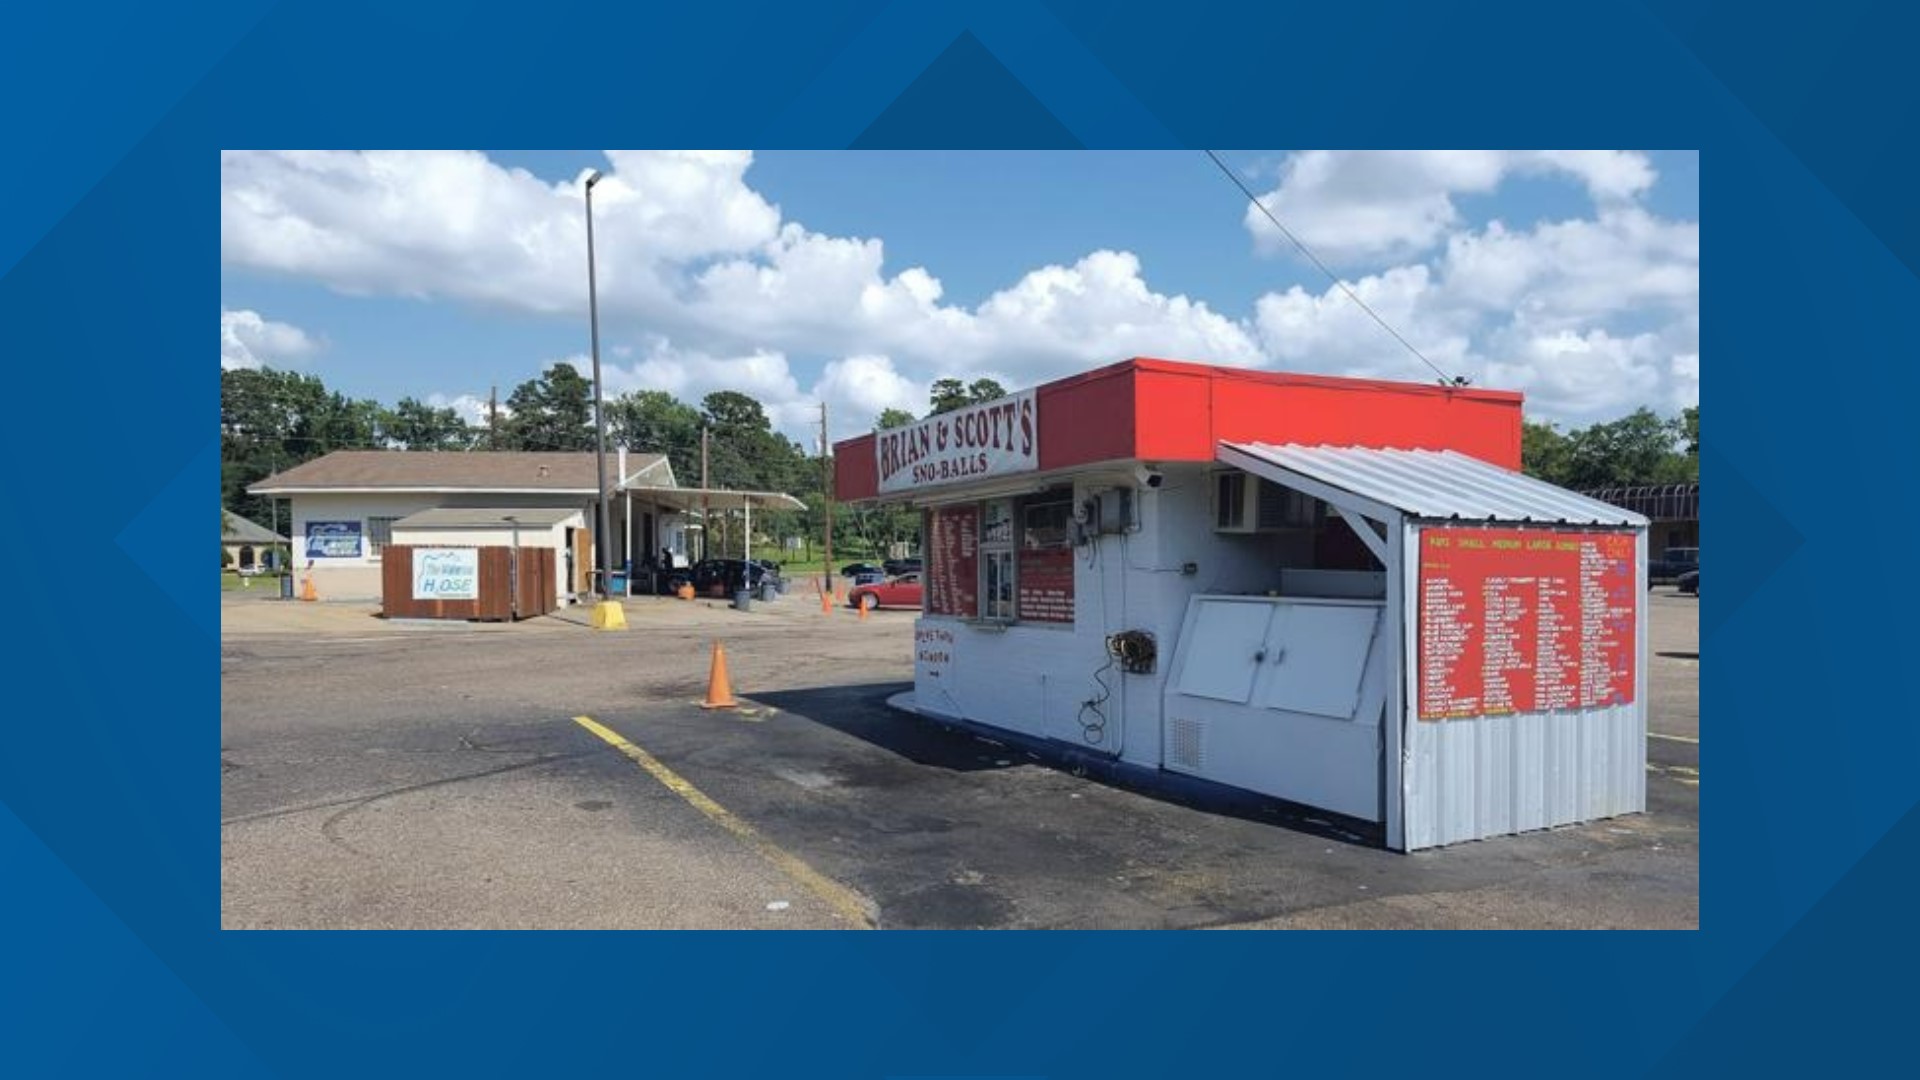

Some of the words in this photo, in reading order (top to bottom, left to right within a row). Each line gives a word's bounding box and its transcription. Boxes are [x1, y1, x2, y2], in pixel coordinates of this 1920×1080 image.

[880, 423, 930, 482] BRIAN
[936, 420, 949, 452] &
[955, 396, 1033, 458] SCOTT'S
[912, 453, 988, 485] SNO-BALLS
